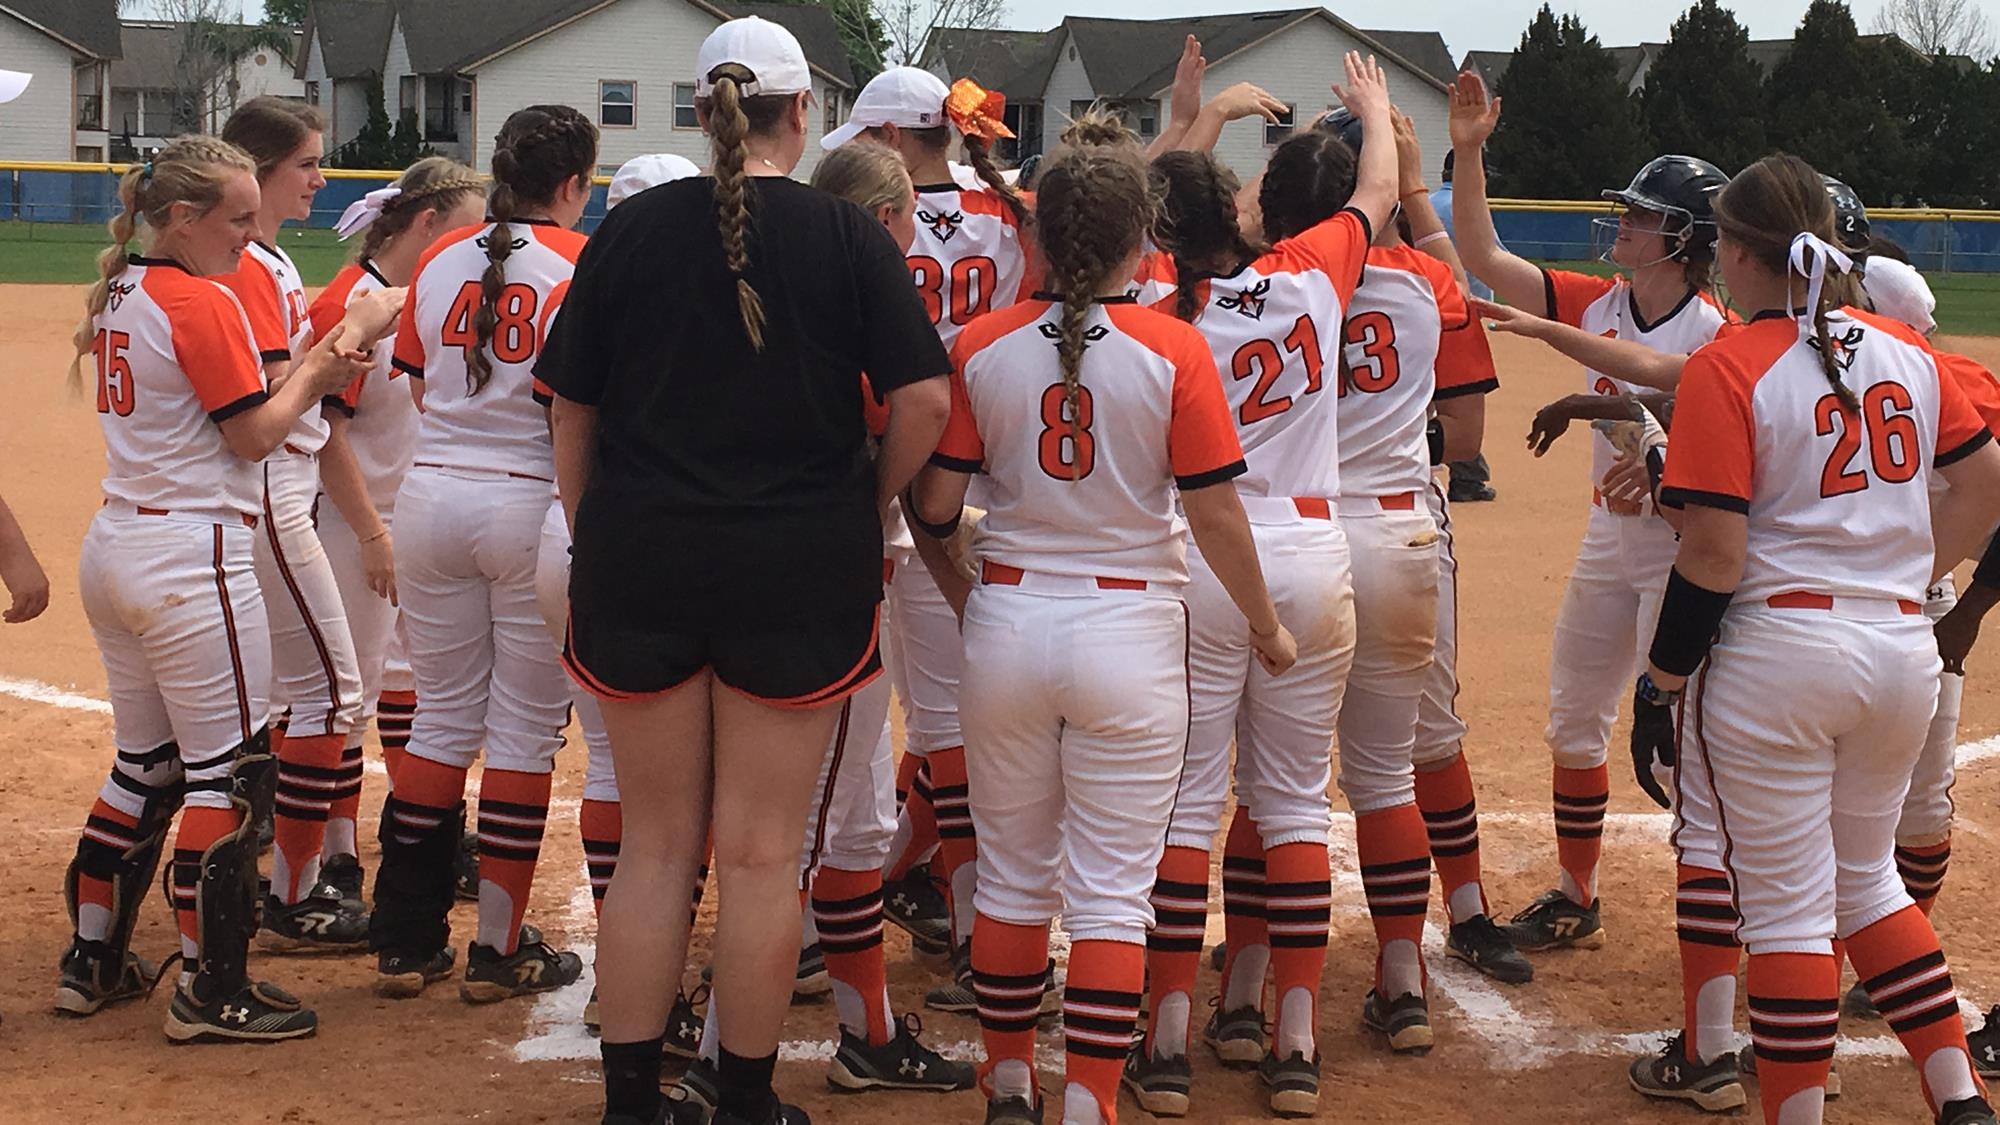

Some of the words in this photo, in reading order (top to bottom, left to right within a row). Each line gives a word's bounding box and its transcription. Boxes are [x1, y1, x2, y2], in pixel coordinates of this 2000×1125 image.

[1846, 215, 1855, 231] 2
[441, 280, 538, 364] 48
[1338, 311, 1400, 398] 3
[92, 327, 136, 417] 15
[1231, 313, 1324, 426] 21
[1038, 382, 1095, 481] 8
[1814, 380, 1921, 499] 26
